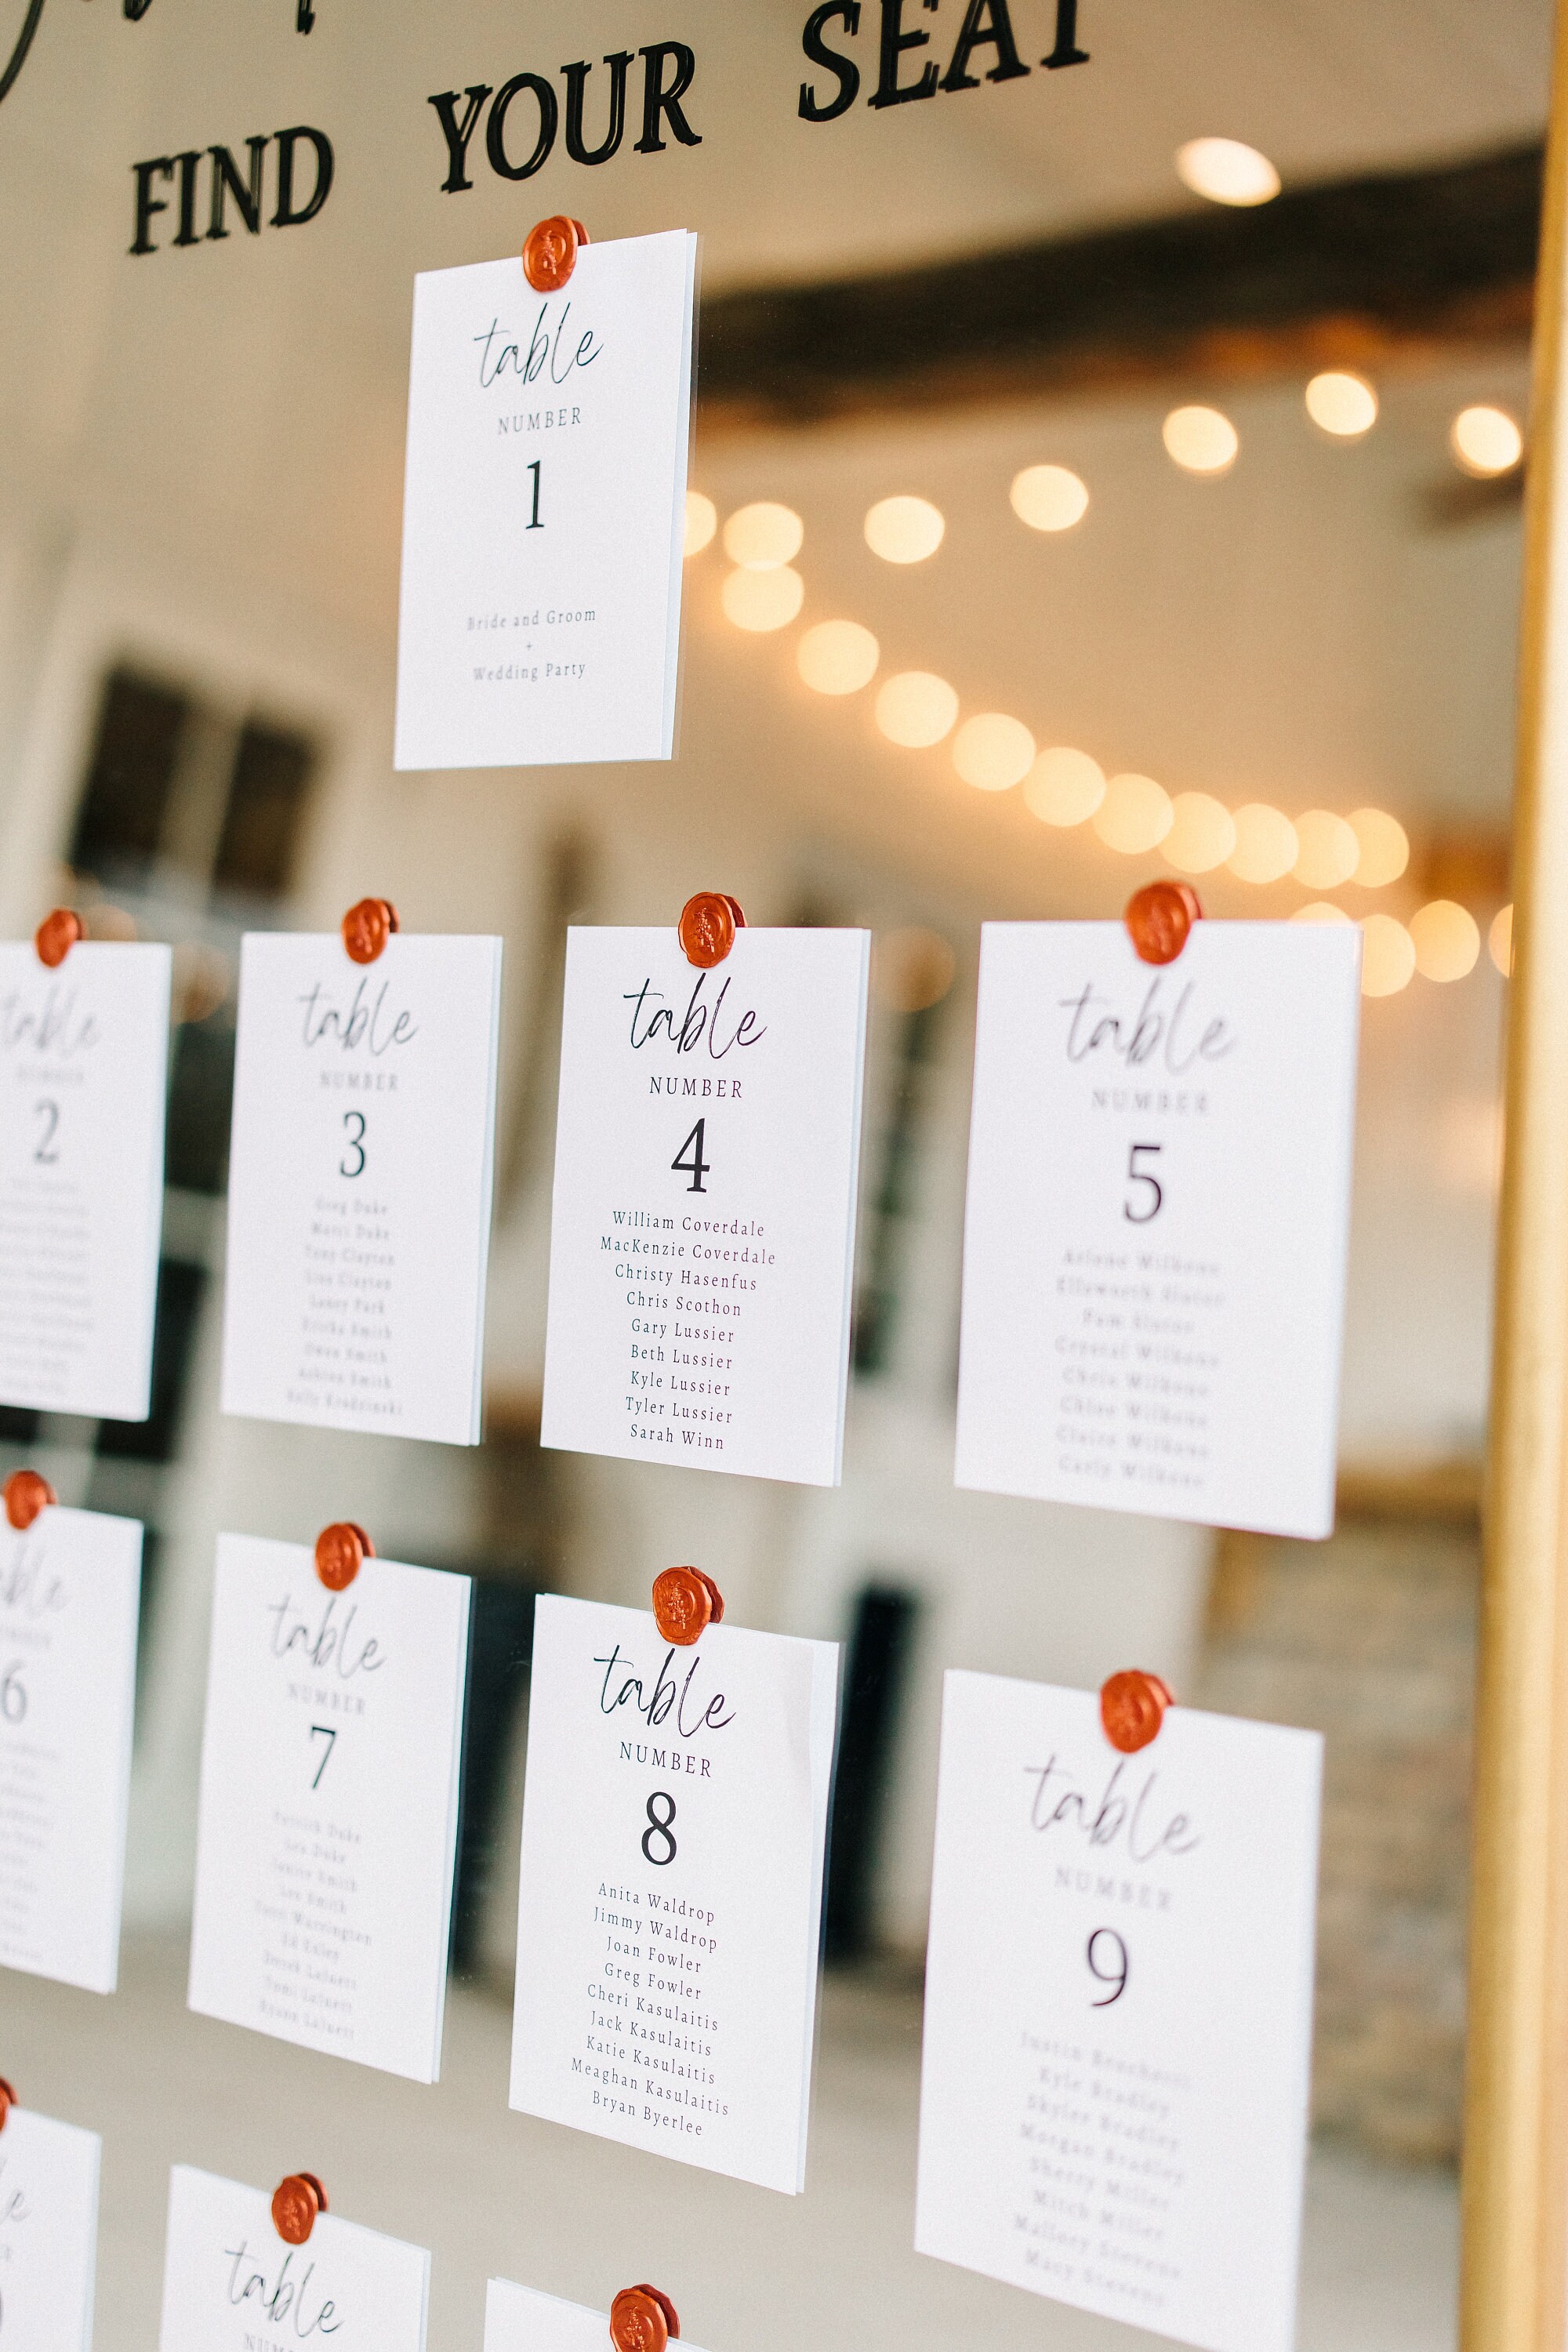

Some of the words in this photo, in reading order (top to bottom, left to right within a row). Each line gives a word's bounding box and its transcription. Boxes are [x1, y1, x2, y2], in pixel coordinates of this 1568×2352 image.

[129, 126, 334, 256] FIND
[427, 41, 702, 194] YOUR
[473, 303, 604, 388] table
[498, 407, 581, 434] NUMBER
[525, 459, 545, 530] 1
[468, 614, 506, 630] Bride
[514, 610, 539, 626] and
[546, 610, 595, 624] Groom
[474, 665, 538, 682] Wedding
[546, 663, 586, 679] Party
[298, 978, 418, 1056] table
[622, 971, 768, 1059] table
[1060, 975, 1235, 1073] table
[650, 1076, 742, 1098] NUMBER
[33, 1099, 60, 1165] 2
[339, 1110, 367, 1179] 3
[671, 1118, 710, 1193] 4
[1123, 1142, 1165, 1225] 5
[613, 1211, 673, 1229] William
[683, 1217, 764, 1236] Coverdale
[601, 1236, 684, 1256] MacKenzie
[693, 1245, 775, 1264] Coverdale
[615, 1264, 673, 1286] Christy
[681, 1270, 756, 1290] Hasenfus
[627, 1291, 667, 1308] Chris
[677, 1297, 740, 1316] Scothon
[632, 1319, 666, 1338] Gary
[675, 1323, 733, 1341] Lussier
[631, 1345, 664, 1361] Beth
[673, 1349, 731, 1369] Lussier
[631, 1371, 662, 1389] Kyle
[671, 1376, 729, 1396] Lussier
[626, 1396, 664, 1415] Tyler
[673, 1403, 731, 1423] Lussier
[631, 1424, 673, 1443] Sarah
[682, 1431, 723, 1449] Winn
[268, 1595, 387, 1679] table
[593, 1644, 736, 1737] table
[310, 1723, 338, 1791] 7
[620, 1743, 710, 1777] NUMBER
[641, 1791, 677, 1866] 8
[1025, 1755, 1200, 1861] table
[599, 1883, 639, 1904] Anita
[648, 1893, 713, 1926] Waldrop
[594, 1907, 642, 1934] Jimmy
[650, 1921, 716, 1953] Waldrop
[608, 1936, 639, 1957] Joan
[648, 1947, 700, 1973] Fowler
[1084, 1927, 1131, 2009] 9
[605, 1963, 640, 1987] Greg
[648, 1974, 700, 1999] Fowler
[588, 1984, 627, 2006] Cheri
[637, 1997, 717, 2031] Kasulaitis
[592, 2011, 621, 2031] Jack
[630, 2022, 710, 2056] Kasulaitis
[587, 2036, 625, 2058] Katie
[633, 2049, 713, 2084] Kasulaitis
[572, 2058, 637, 2089] Meaghan
[646, 2080, 728, 2114] Kasulaitis
[593, 2091, 634, 2115] Bryan
[644, 2107, 702, 2135] Byerlee
[225, 2239, 344, 2338] table
